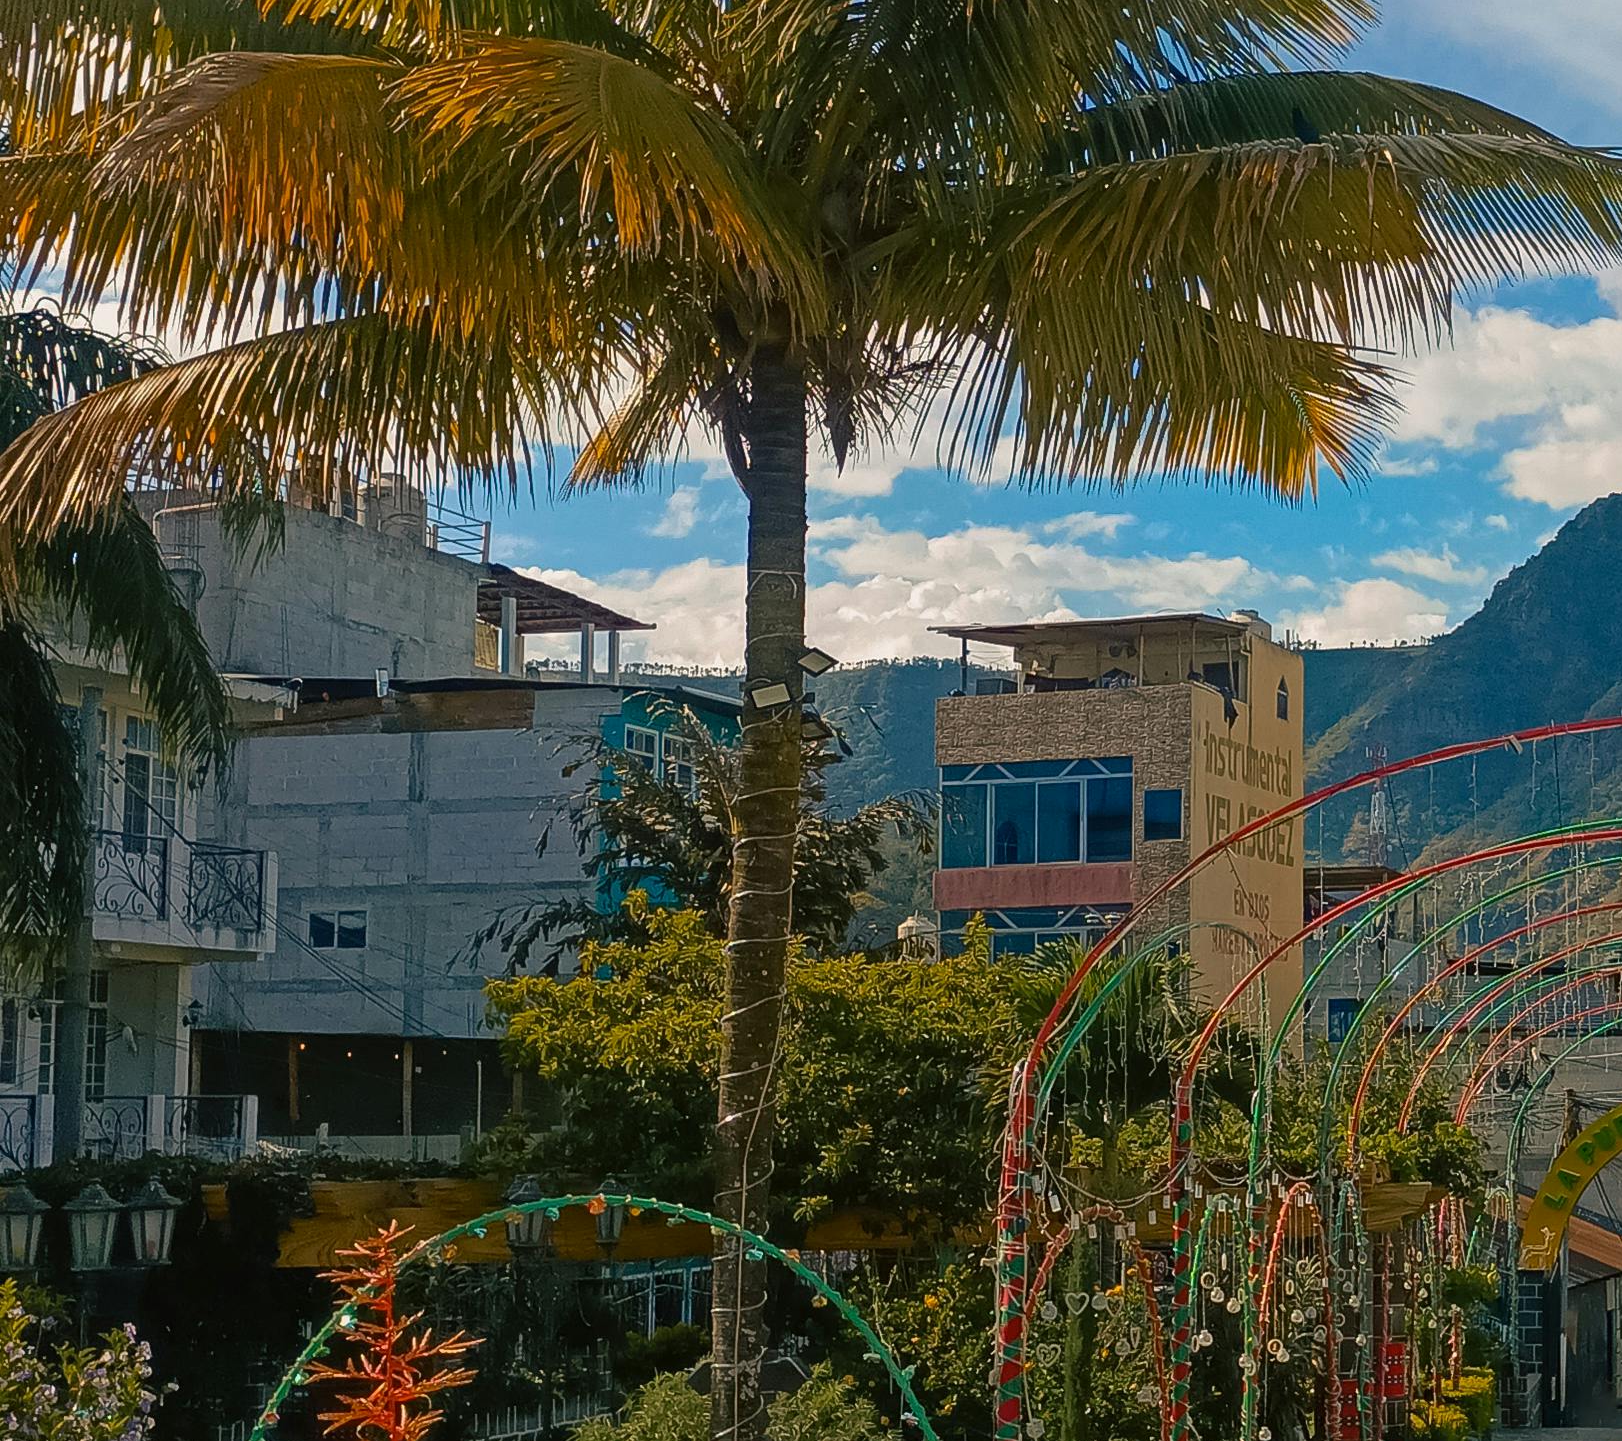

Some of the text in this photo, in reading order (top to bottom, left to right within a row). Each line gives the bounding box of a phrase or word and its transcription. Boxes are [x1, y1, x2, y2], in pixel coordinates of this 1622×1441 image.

[1204, 720, 1292, 797] Instrumental
[1206, 792, 1294, 867] VELASQUEZ
[1543, 1169, 1581, 1209] LA
